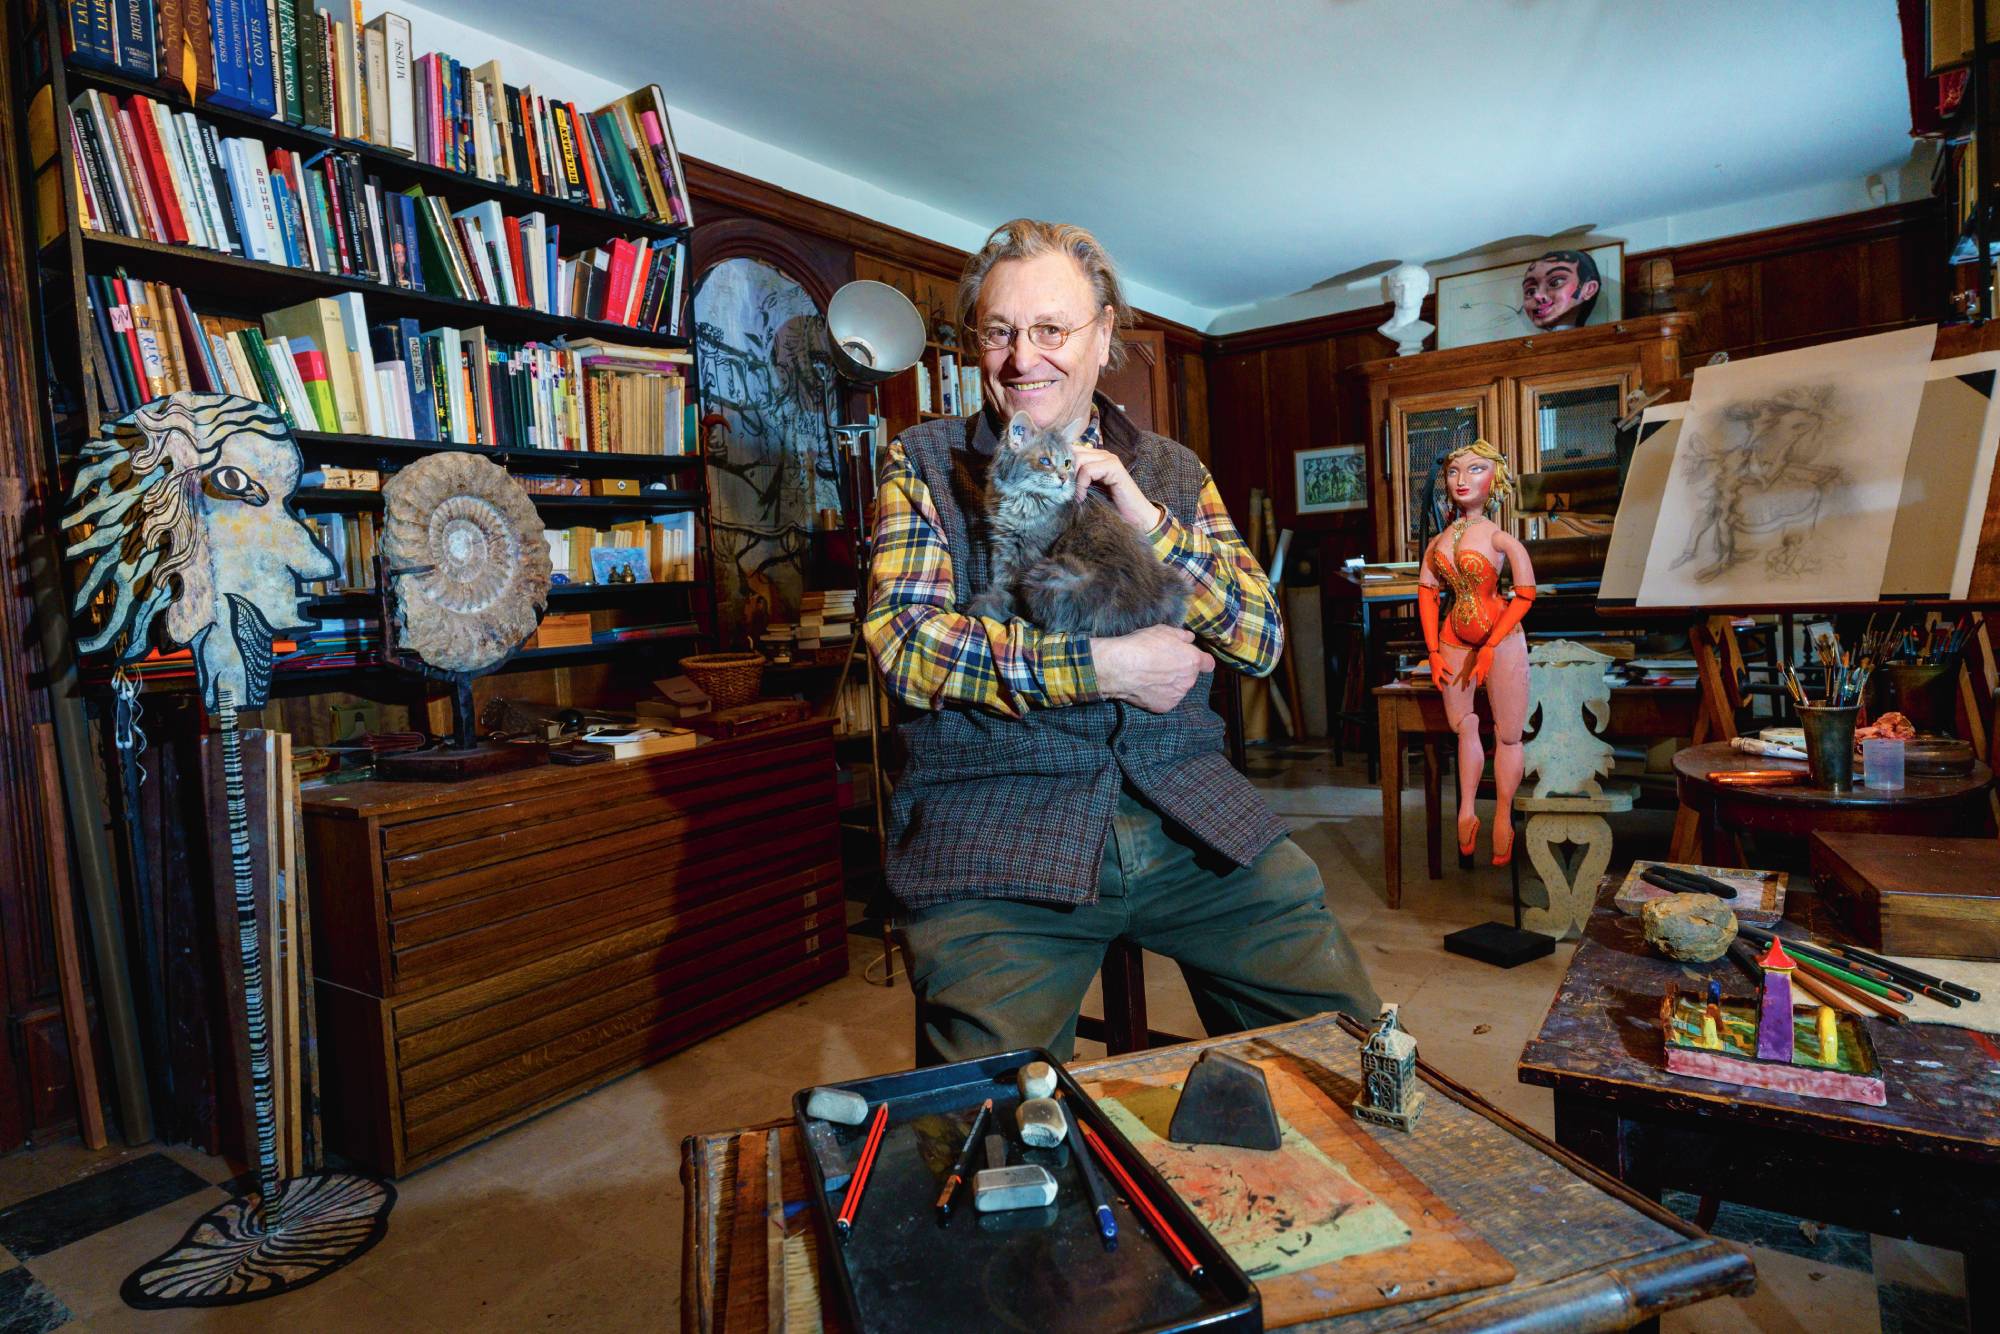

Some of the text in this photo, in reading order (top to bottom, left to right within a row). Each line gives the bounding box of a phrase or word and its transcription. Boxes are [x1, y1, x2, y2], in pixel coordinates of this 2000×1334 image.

[96, 16, 109, 31] LA
[250, 18, 265, 66] CONTES
[303, 14, 315, 93] PICASSO
[394, 38, 406, 79] MATISSE
[76, 117, 88, 139] RITUAL
[83, 139, 91, 150] ART
[202, 128, 217, 165] MONDRIAN
[86, 150, 94, 160] OF
[88, 160, 98, 179] INDIA
[560, 128, 578, 182] BECKMANN
[255, 168, 276, 230] BAUHAUS
